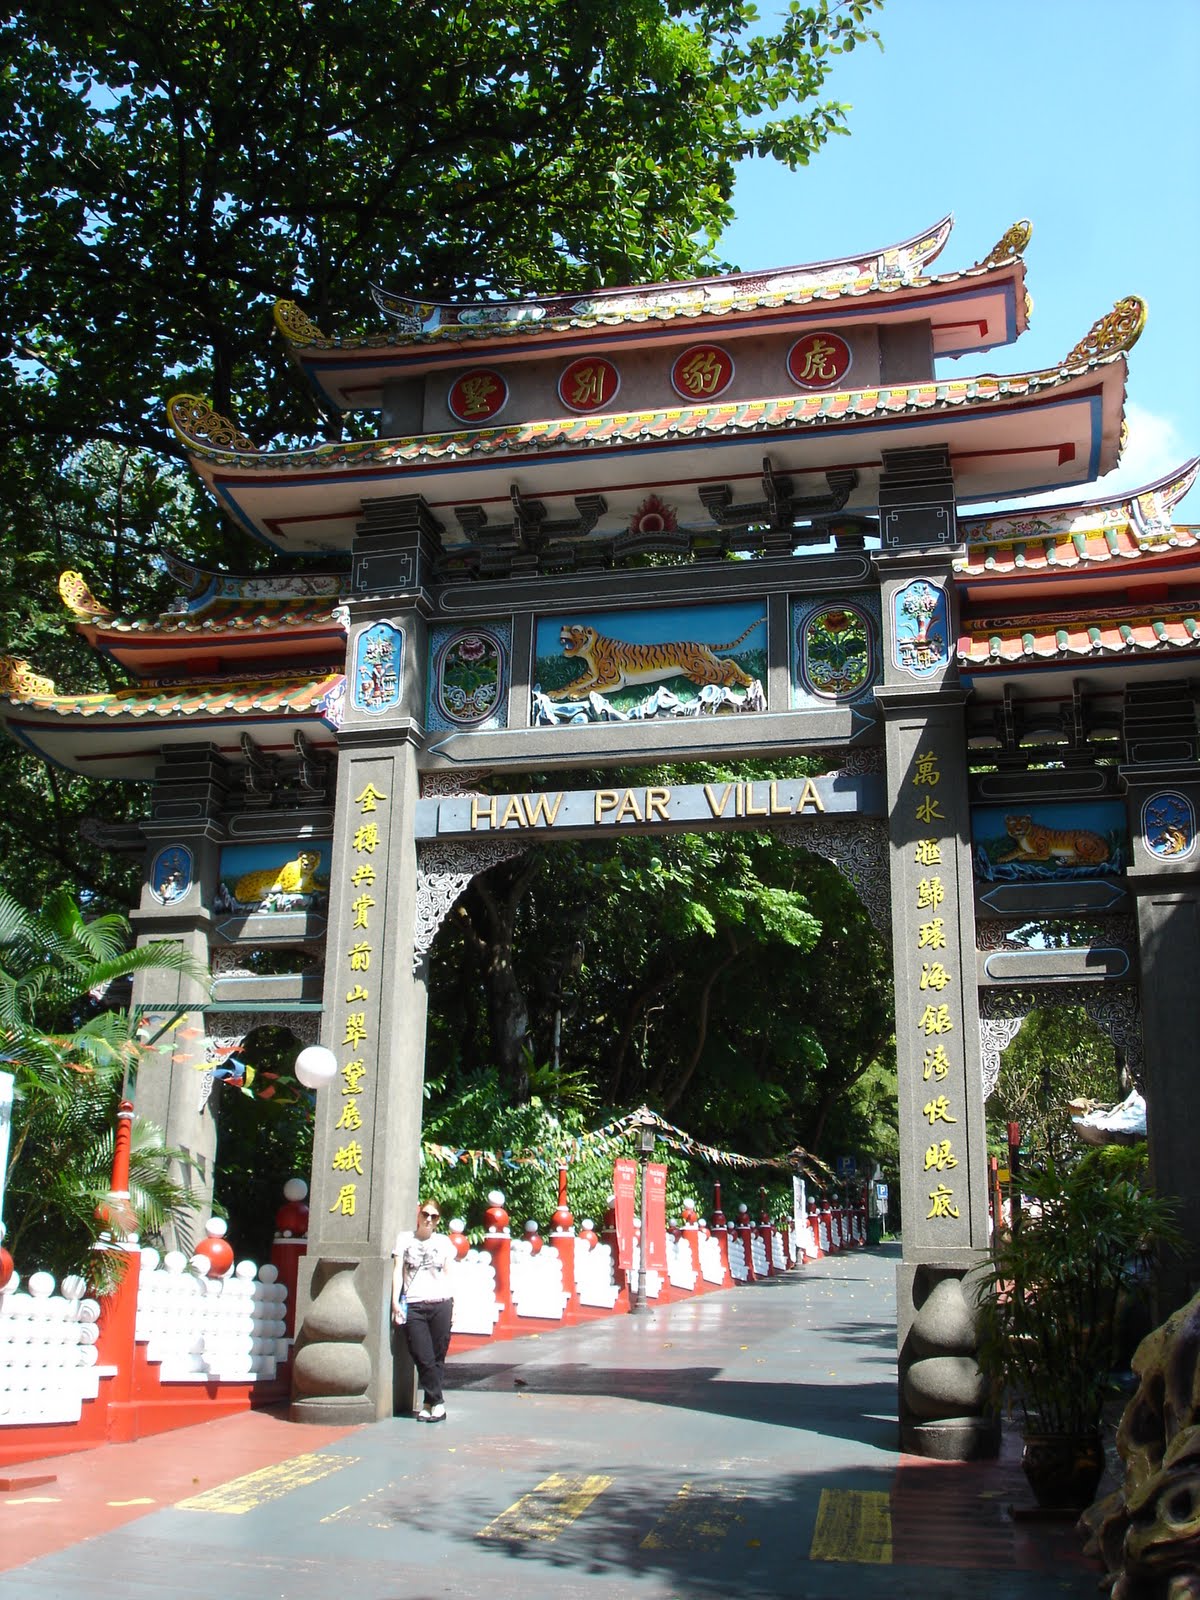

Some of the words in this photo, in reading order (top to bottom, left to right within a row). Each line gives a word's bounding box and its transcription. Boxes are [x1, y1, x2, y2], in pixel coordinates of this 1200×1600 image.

[470, 793, 564, 829] HAW
[595, 787, 671, 823] PAR
[703, 779, 825, 817] VILLA
